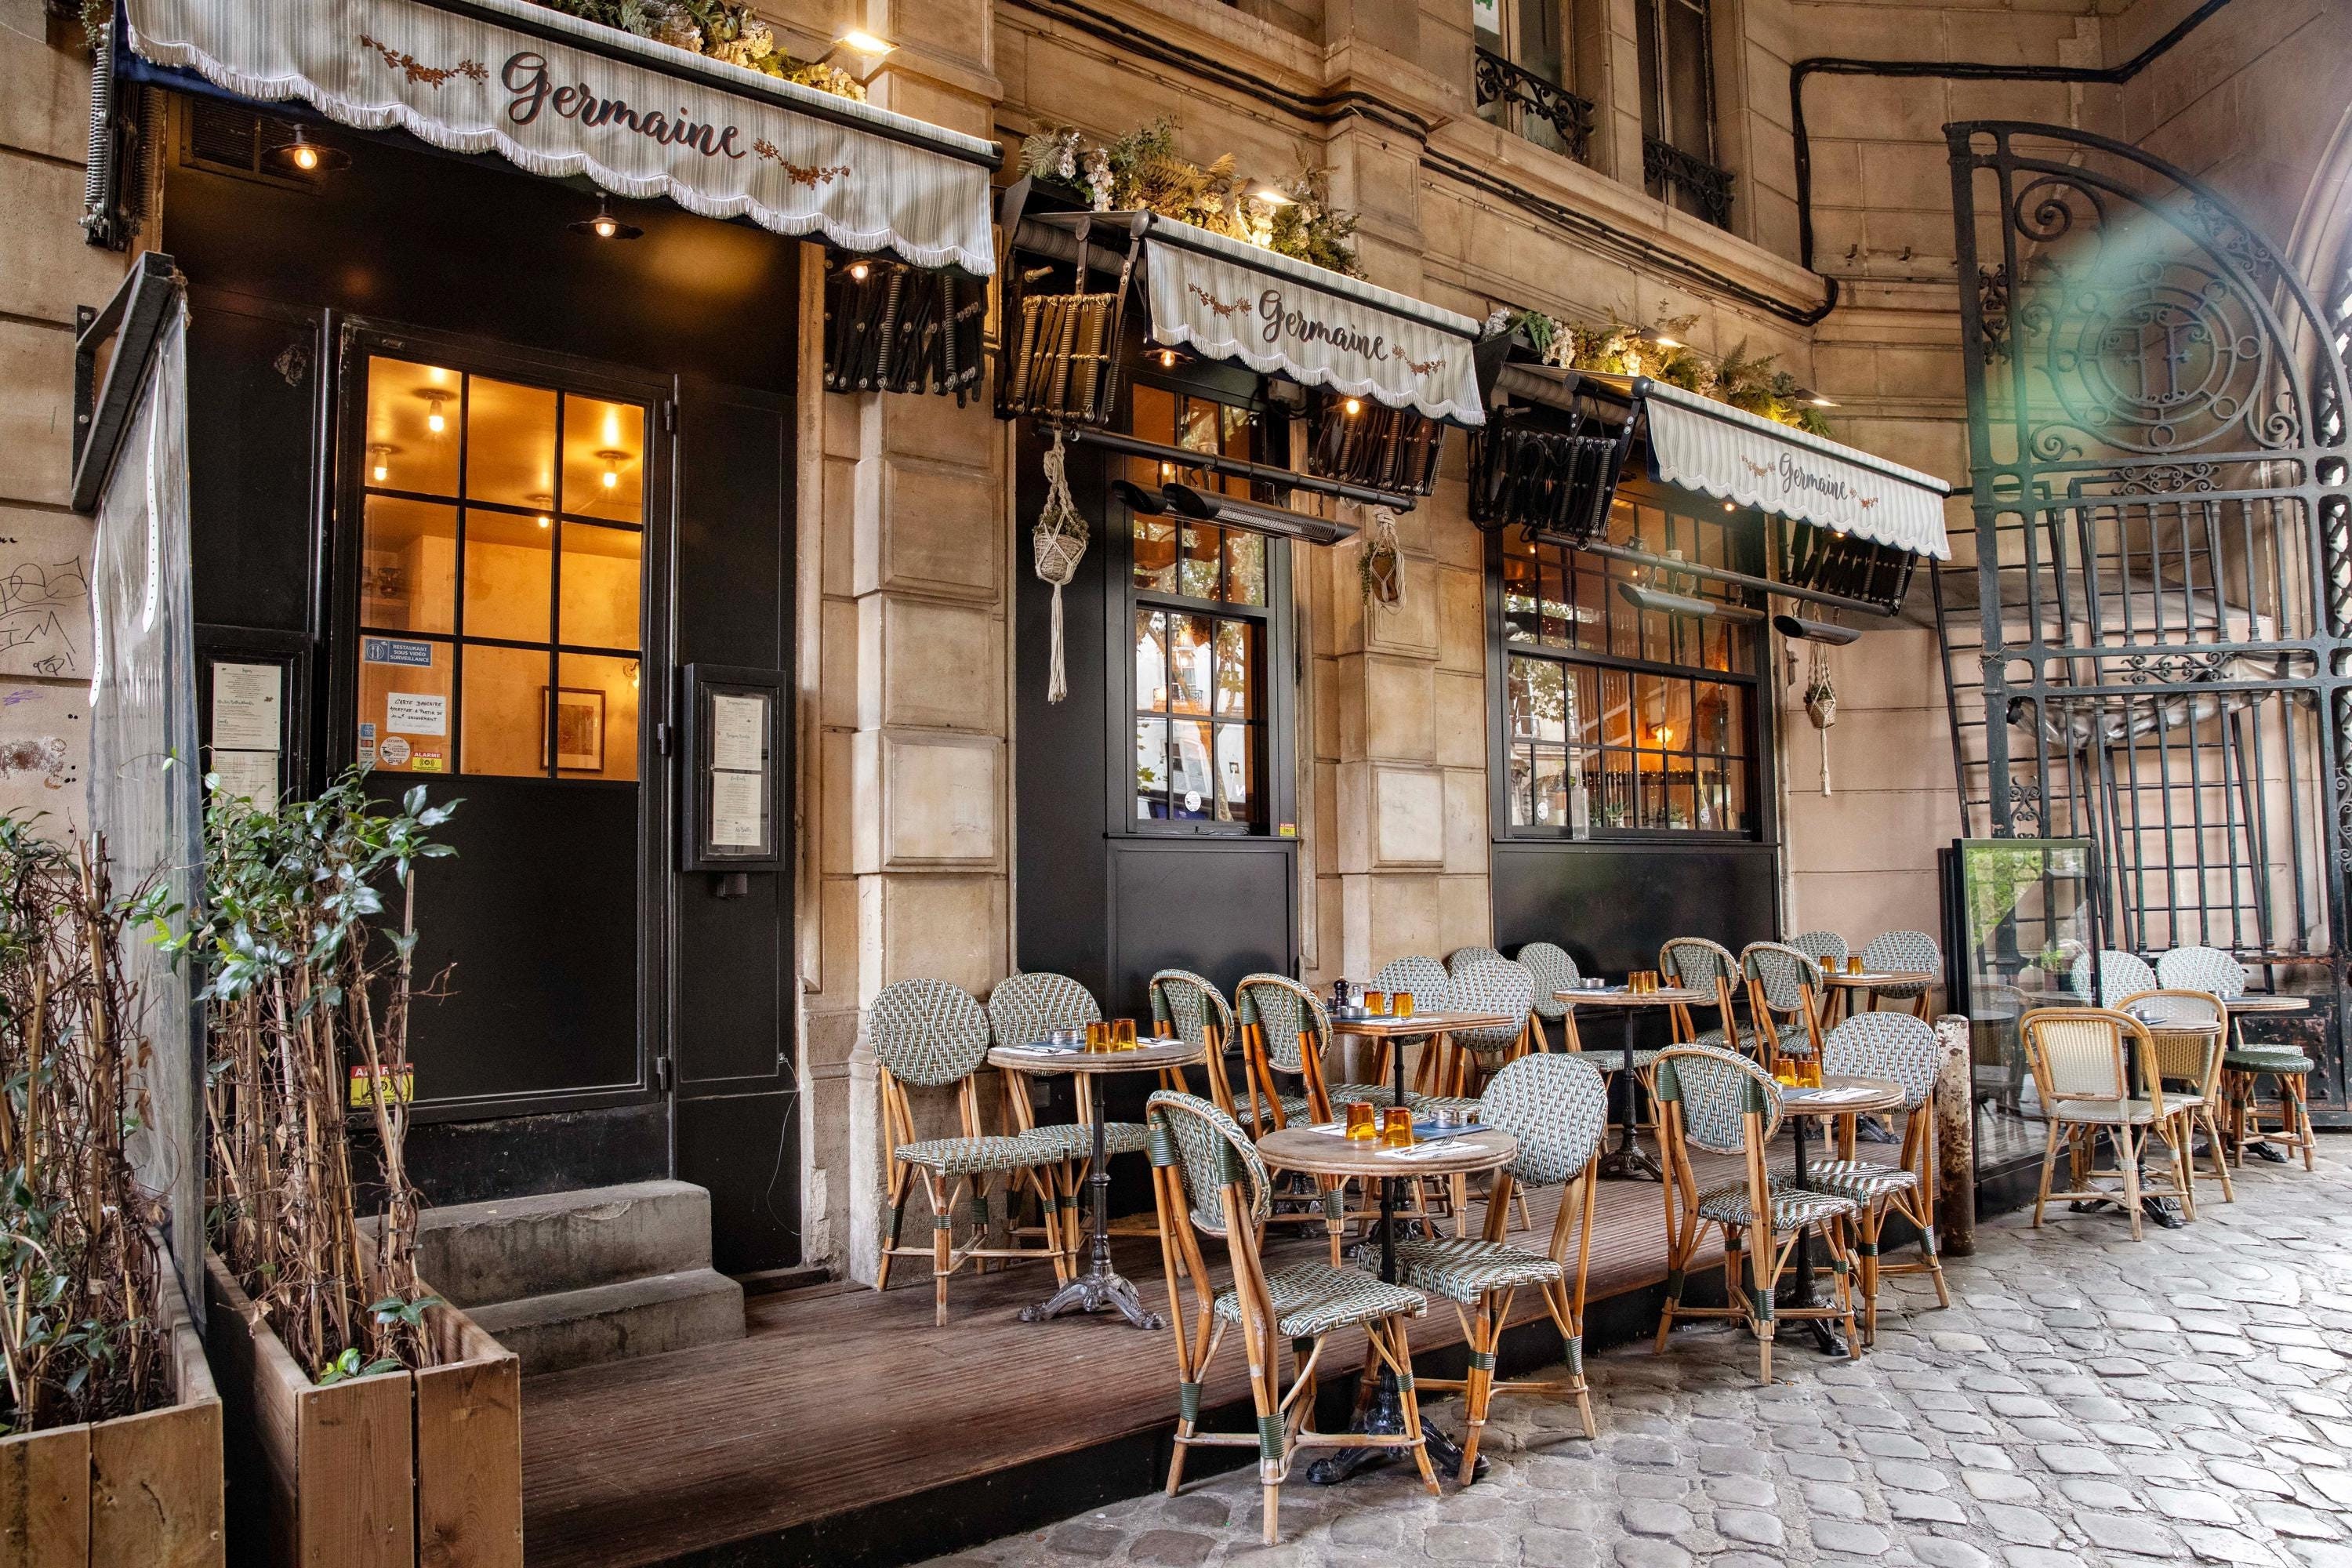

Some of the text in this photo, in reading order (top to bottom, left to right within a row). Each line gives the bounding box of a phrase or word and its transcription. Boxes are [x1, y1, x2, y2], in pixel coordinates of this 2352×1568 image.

[501, 51, 746, 159] Germaine
[1258, 289, 1388, 361] Germaine
[1779, 452, 1848, 500] Germaine
